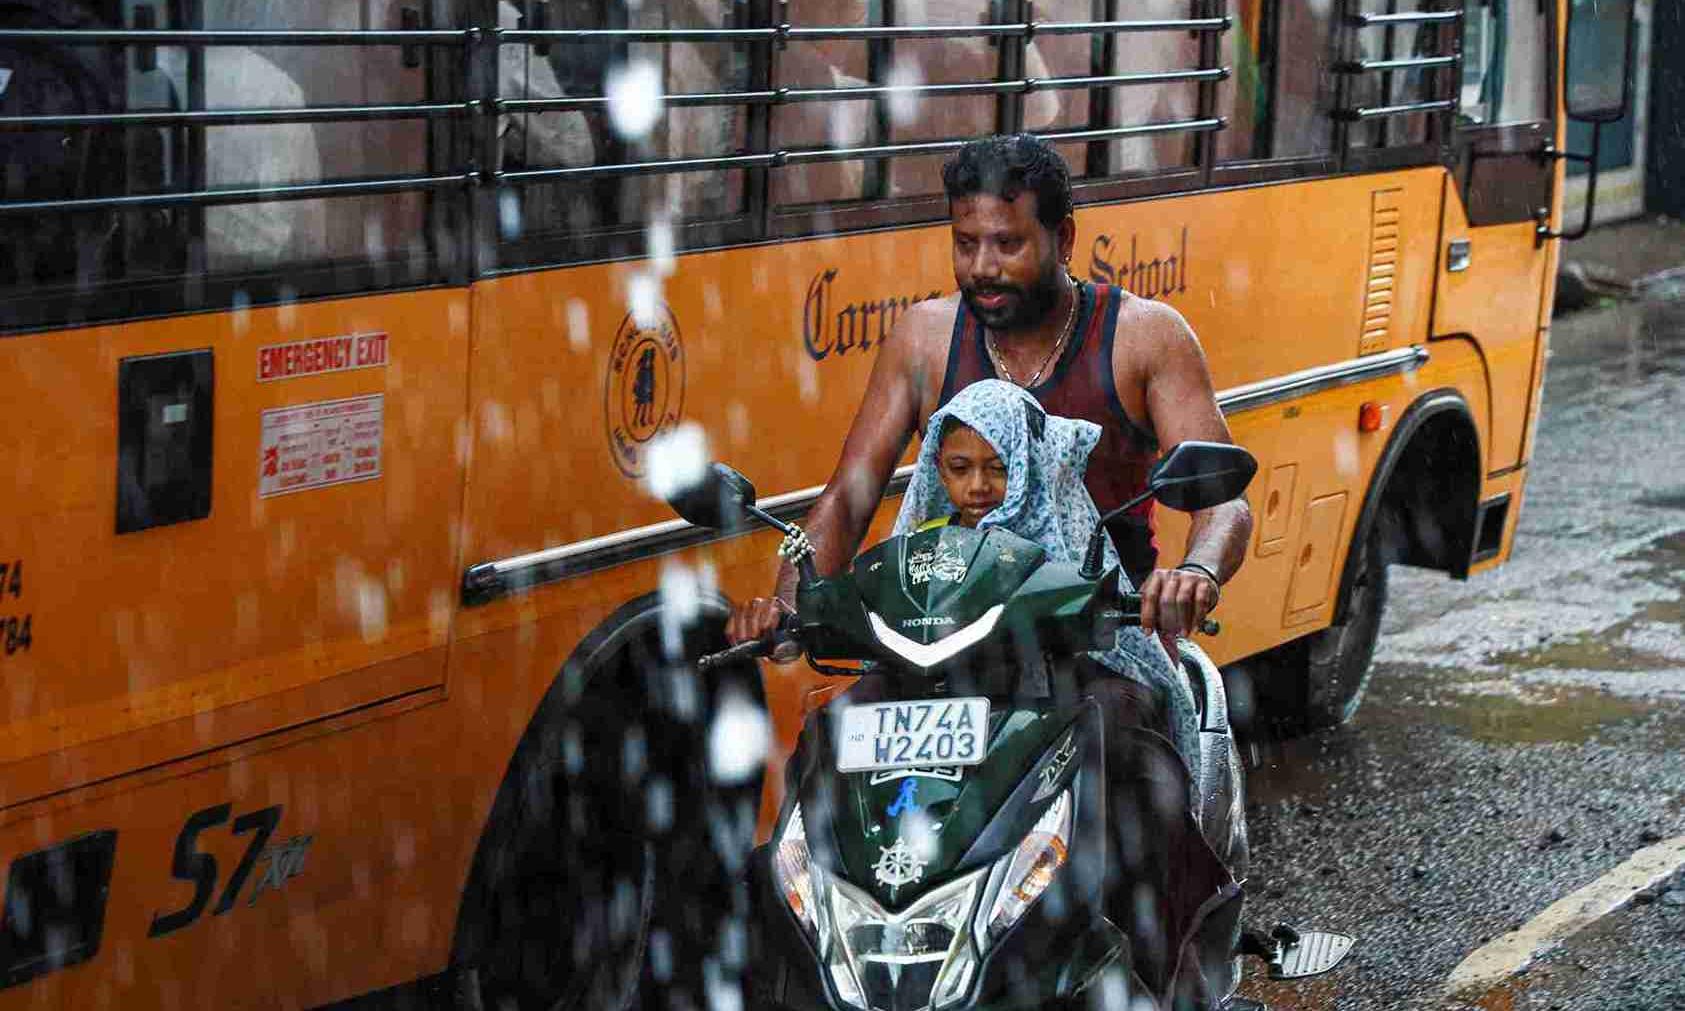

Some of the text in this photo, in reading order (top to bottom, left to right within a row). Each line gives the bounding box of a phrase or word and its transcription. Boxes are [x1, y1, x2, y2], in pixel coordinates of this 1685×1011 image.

[804, 226, 1187, 361] Corp School
[260, 334, 387, 379] EMERGENCY EXIT
[903, 616, 956, 628] HONDA
[874, 703, 973, 734] TN74A
